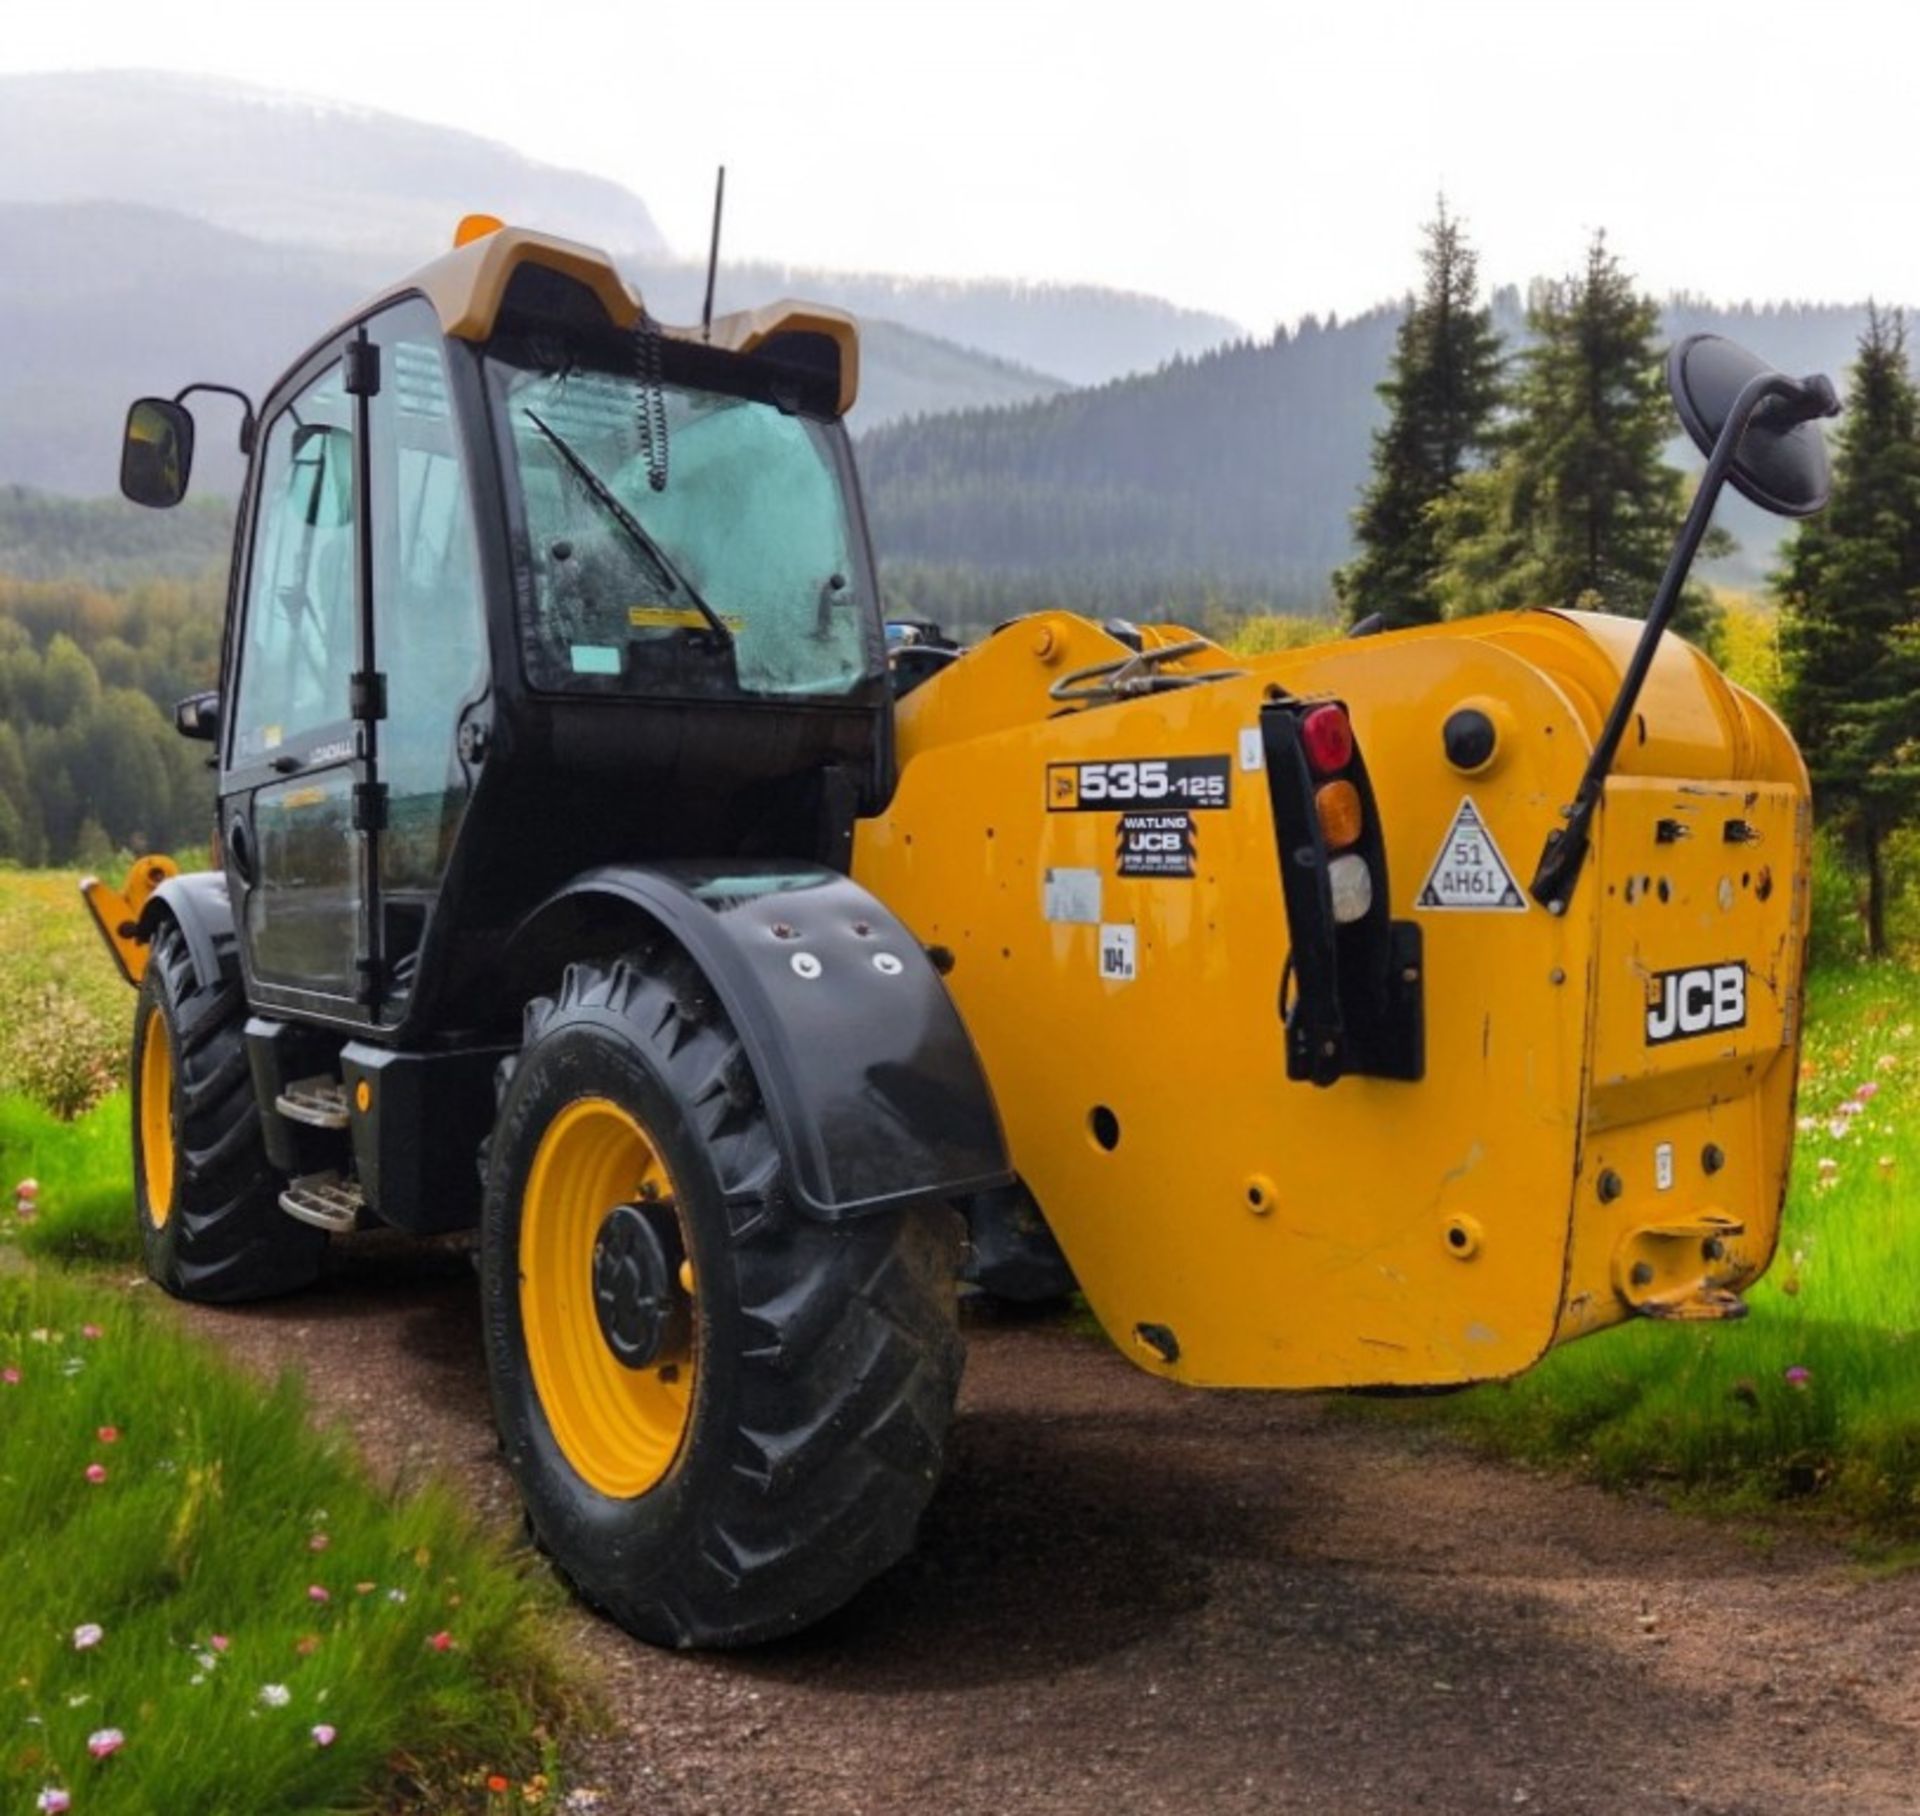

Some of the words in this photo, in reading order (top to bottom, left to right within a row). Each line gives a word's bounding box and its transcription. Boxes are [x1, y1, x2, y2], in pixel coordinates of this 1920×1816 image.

[1129, 832, 1181, 851] JCB
[1454, 843, 1483, 866] 51
[1104, 946, 1124, 975] 104
[1648, 966, 1744, 1039] JCB
